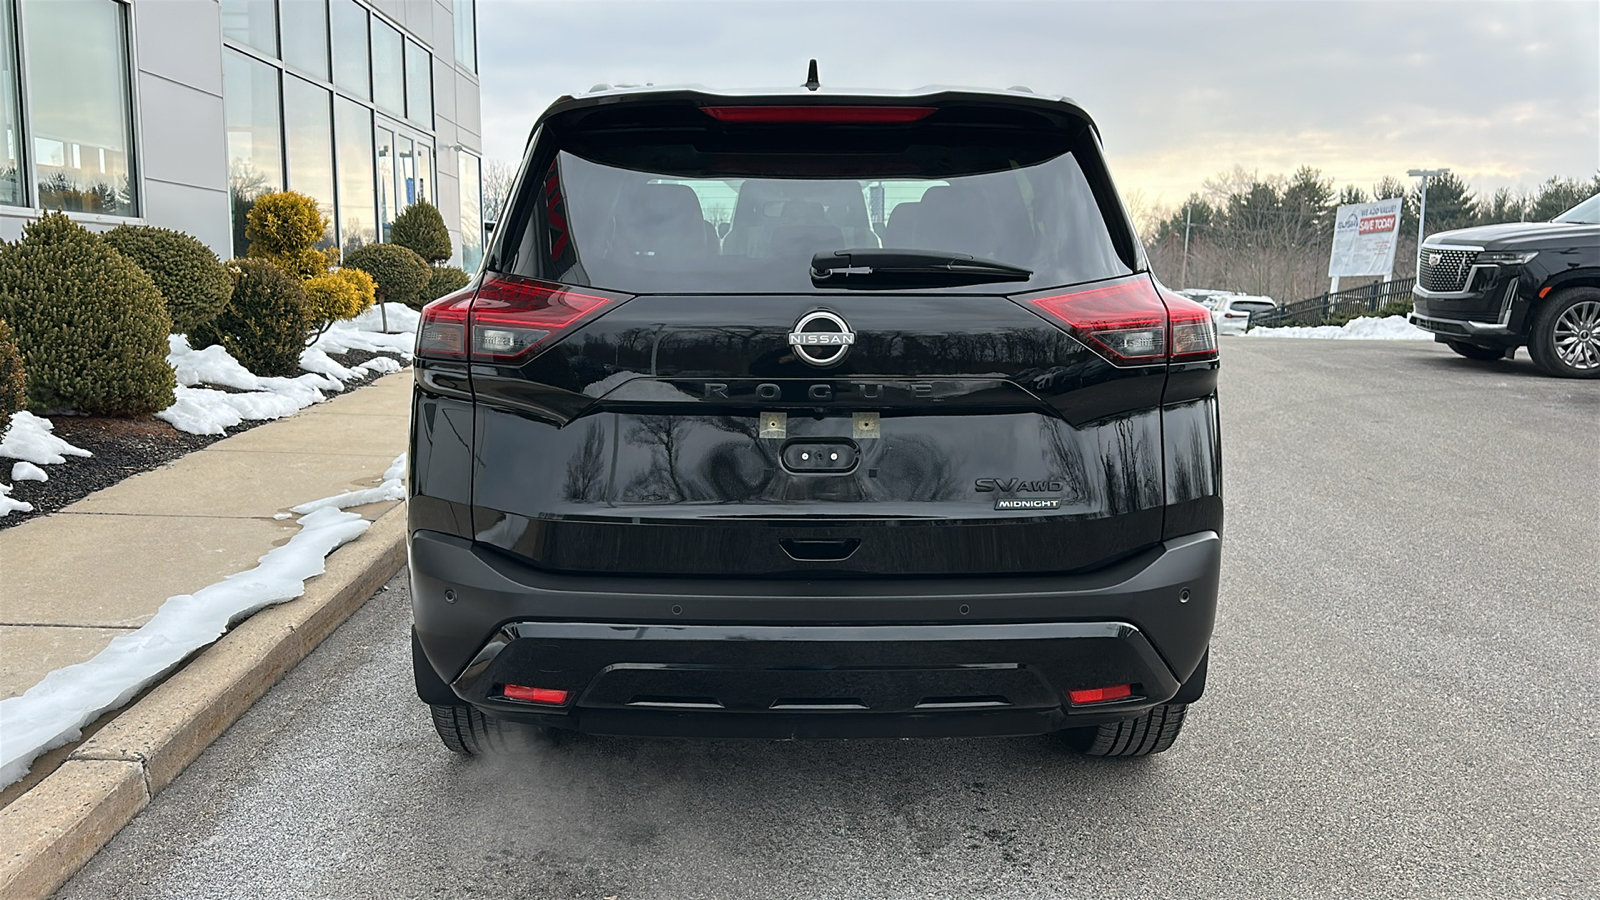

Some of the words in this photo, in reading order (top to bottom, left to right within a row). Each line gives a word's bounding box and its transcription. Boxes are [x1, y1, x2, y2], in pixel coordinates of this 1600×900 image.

[1369, 208, 1379, 216] ADD
[1359, 219, 1374, 231] SAVE
[1374, 217, 1395, 229] TODAY
[790, 335, 853, 344] NISSAN
[704, 382, 933, 399] ROGUE
[974, 478, 1018, 493] SV
[1016, 480, 1063, 493] AWD
[999, 500, 1059, 508] MIDNIGHT
